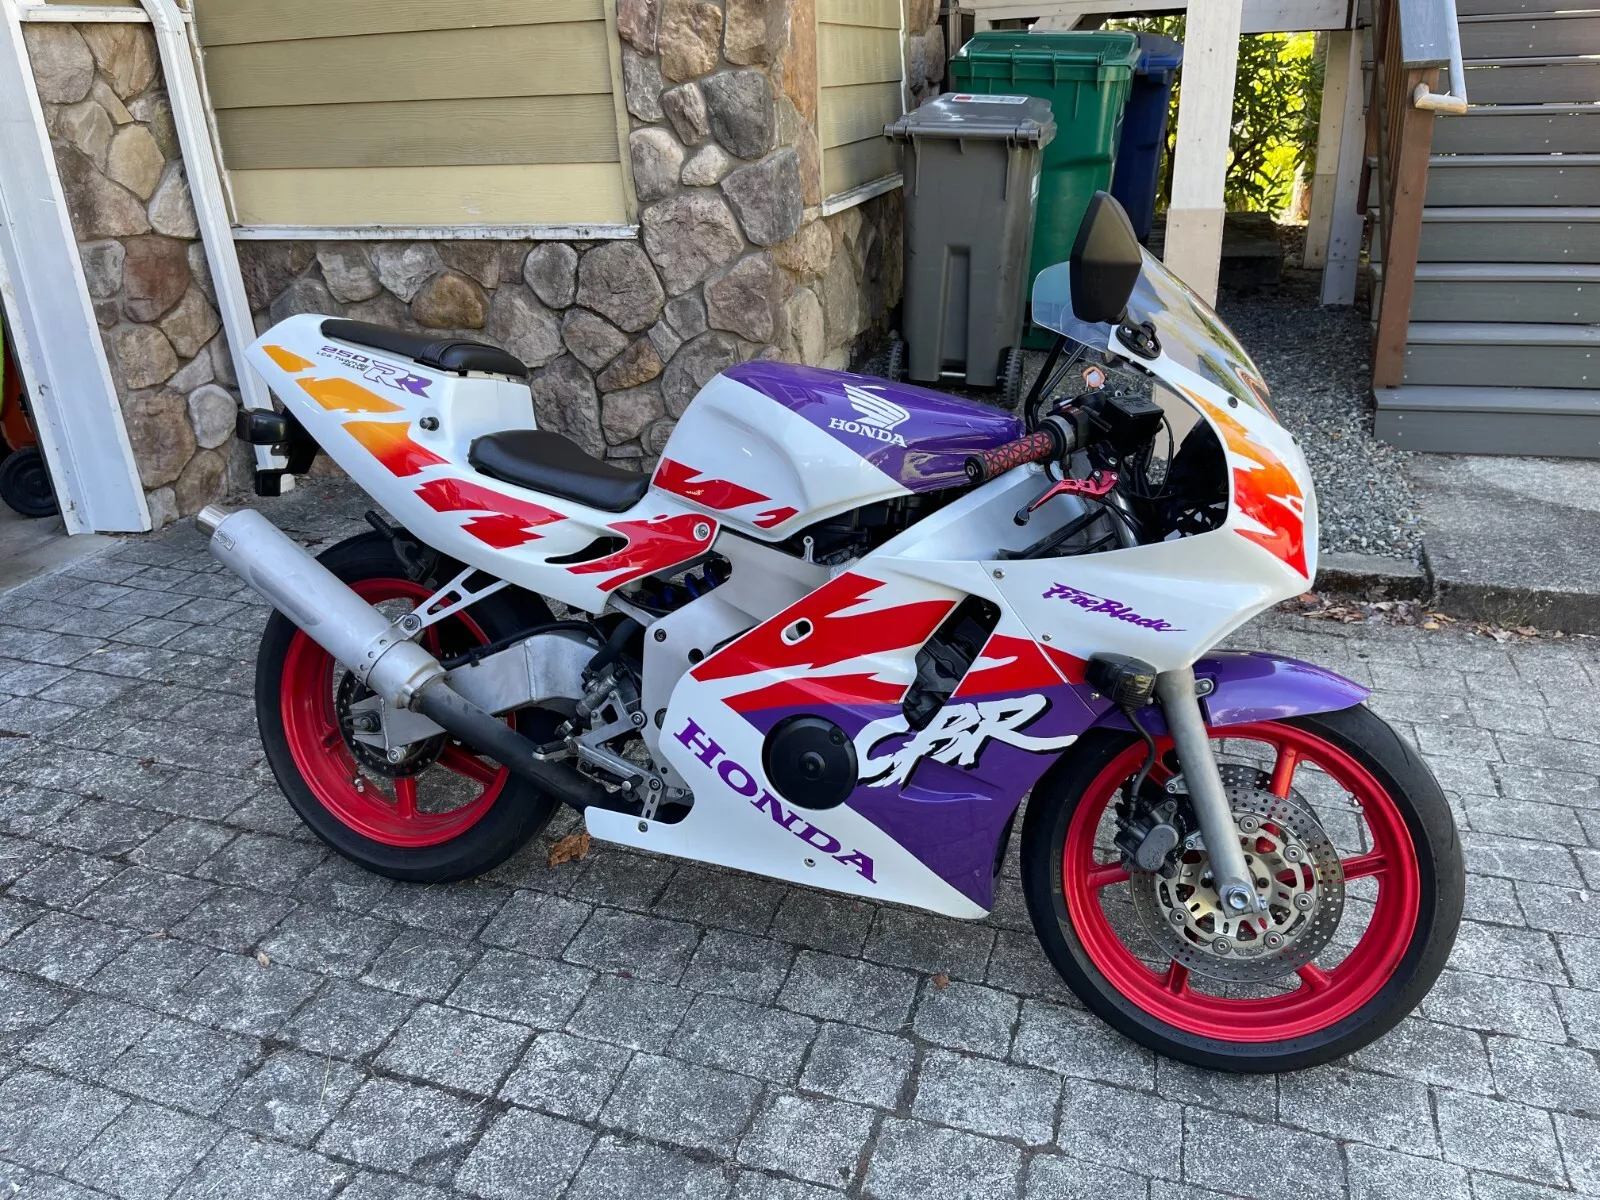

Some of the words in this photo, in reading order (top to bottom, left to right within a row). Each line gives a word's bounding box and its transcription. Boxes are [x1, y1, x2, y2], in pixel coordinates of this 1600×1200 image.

[321, 345, 370, 362] 250
[828, 418, 908, 448] HONDA
[854, 693, 1079, 790] CBR
[673, 716, 879, 885] HONDA
